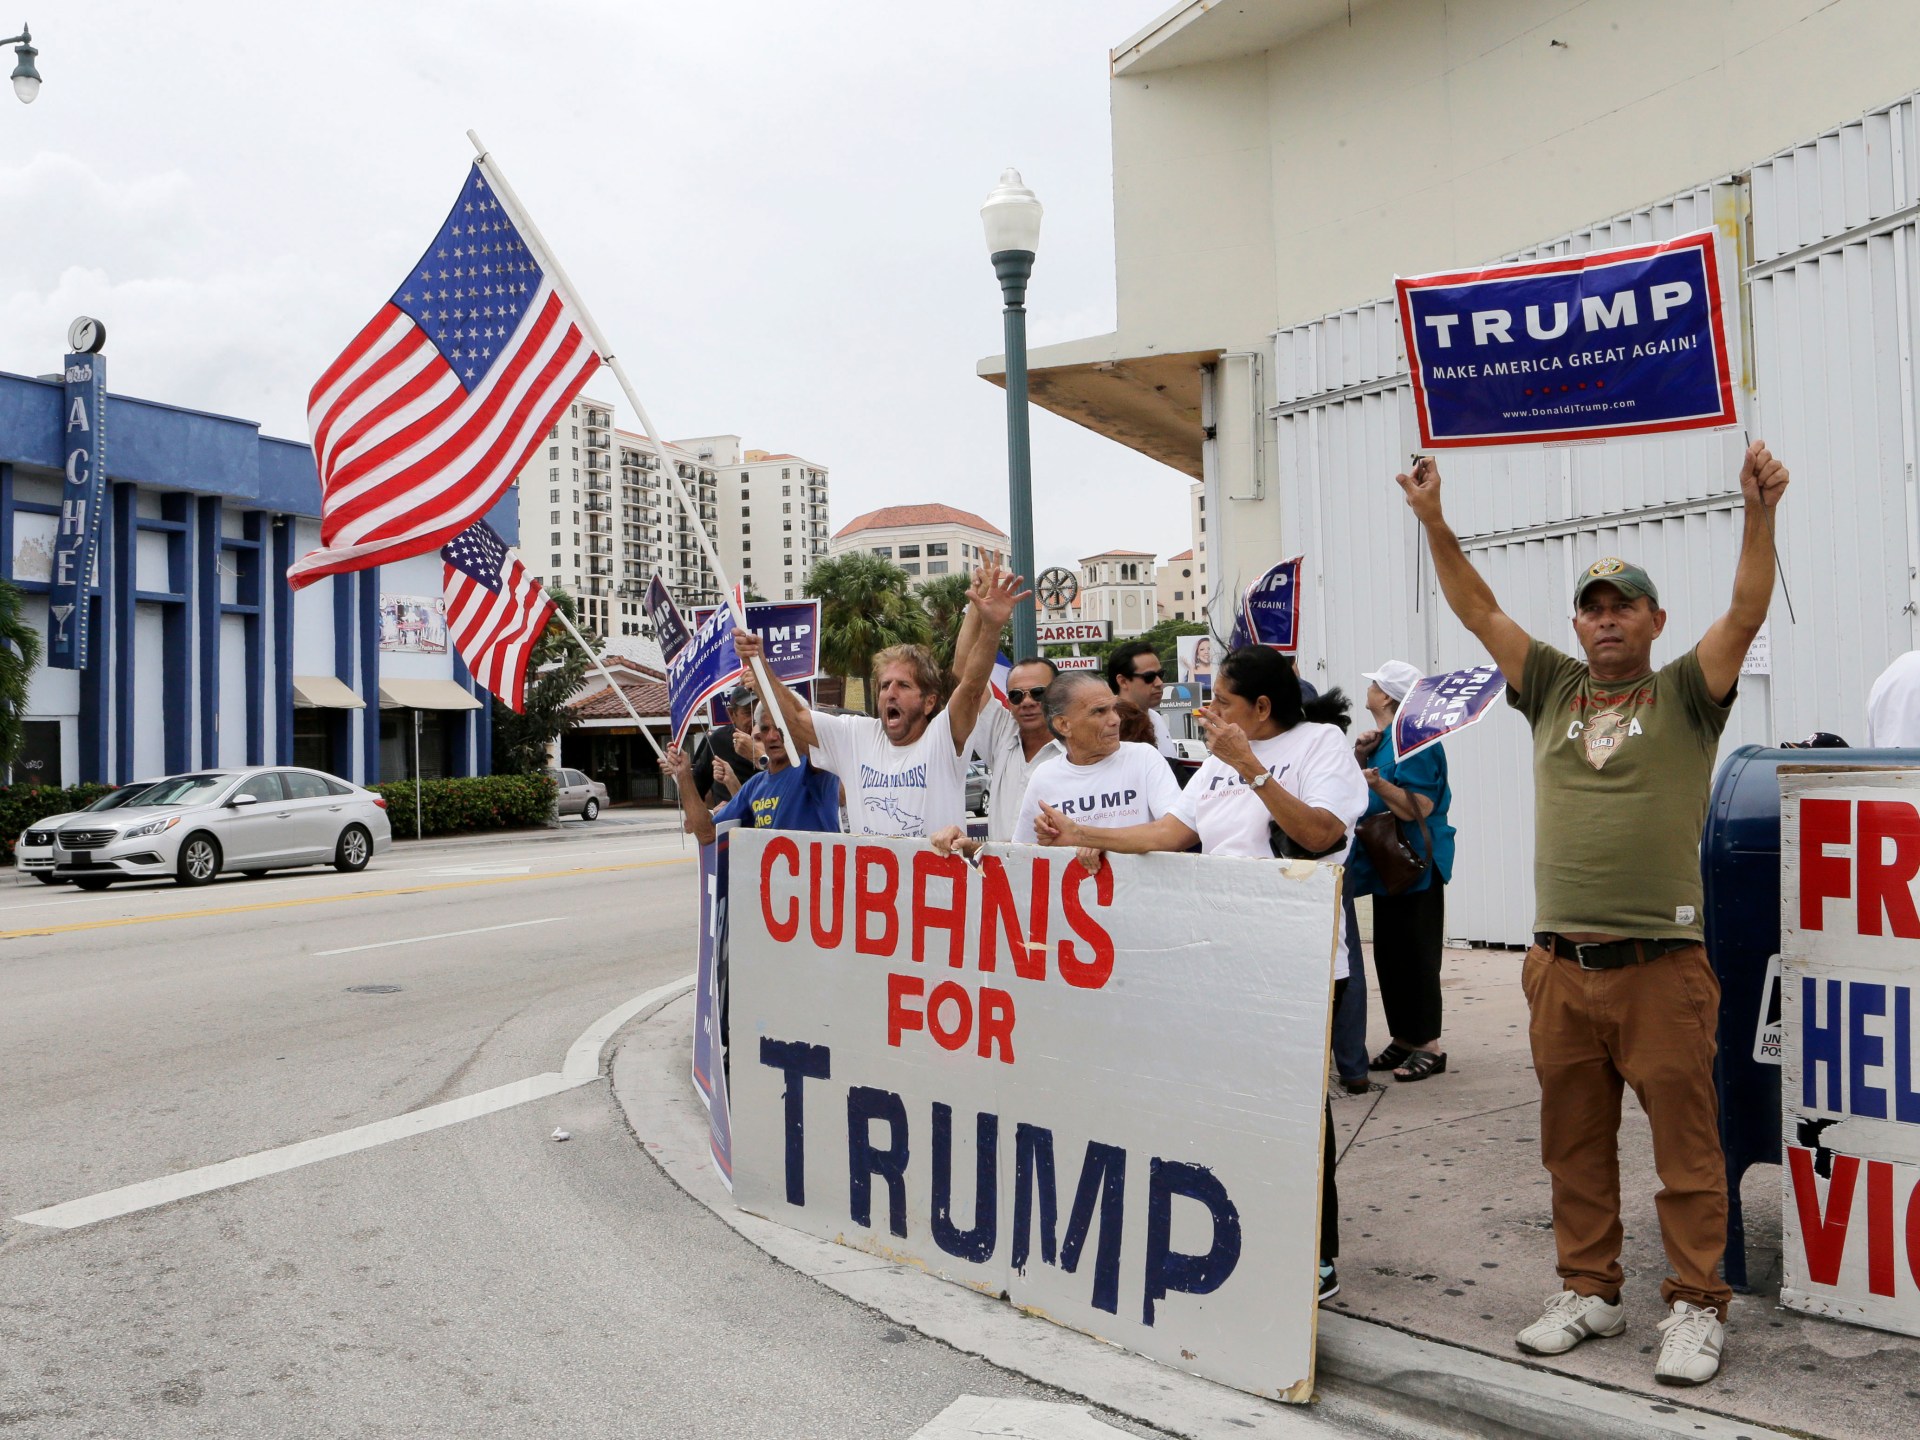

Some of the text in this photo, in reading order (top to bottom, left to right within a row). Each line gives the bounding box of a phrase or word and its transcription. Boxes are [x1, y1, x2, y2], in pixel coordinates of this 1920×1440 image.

[1424, 280, 1693, 348] TRUMP
[1432, 334, 1698, 380] MAKE AMERICA GREAT AGAIN!
[1502, 399, 1636, 419] www.DonaldJTrump.com
[669, 607, 731, 689] TRUMP
[1036, 625, 1102, 641] CARRETA
[1057, 660, 1095, 669] URANT
[1442, 664, 1498, 726] TRUMP
[1799, 798, 1920, 940] FR
[760, 836, 1115, 990] CUBANS
[887, 972, 1015, 1064] FOR
[1763, 1033, 1781, 1044] UN
[1802, 976, 1920, 1124] HEL
[759, 1035, 1242, 1327] TRUMP
[1787, 1146, 1920, 1298] VI
